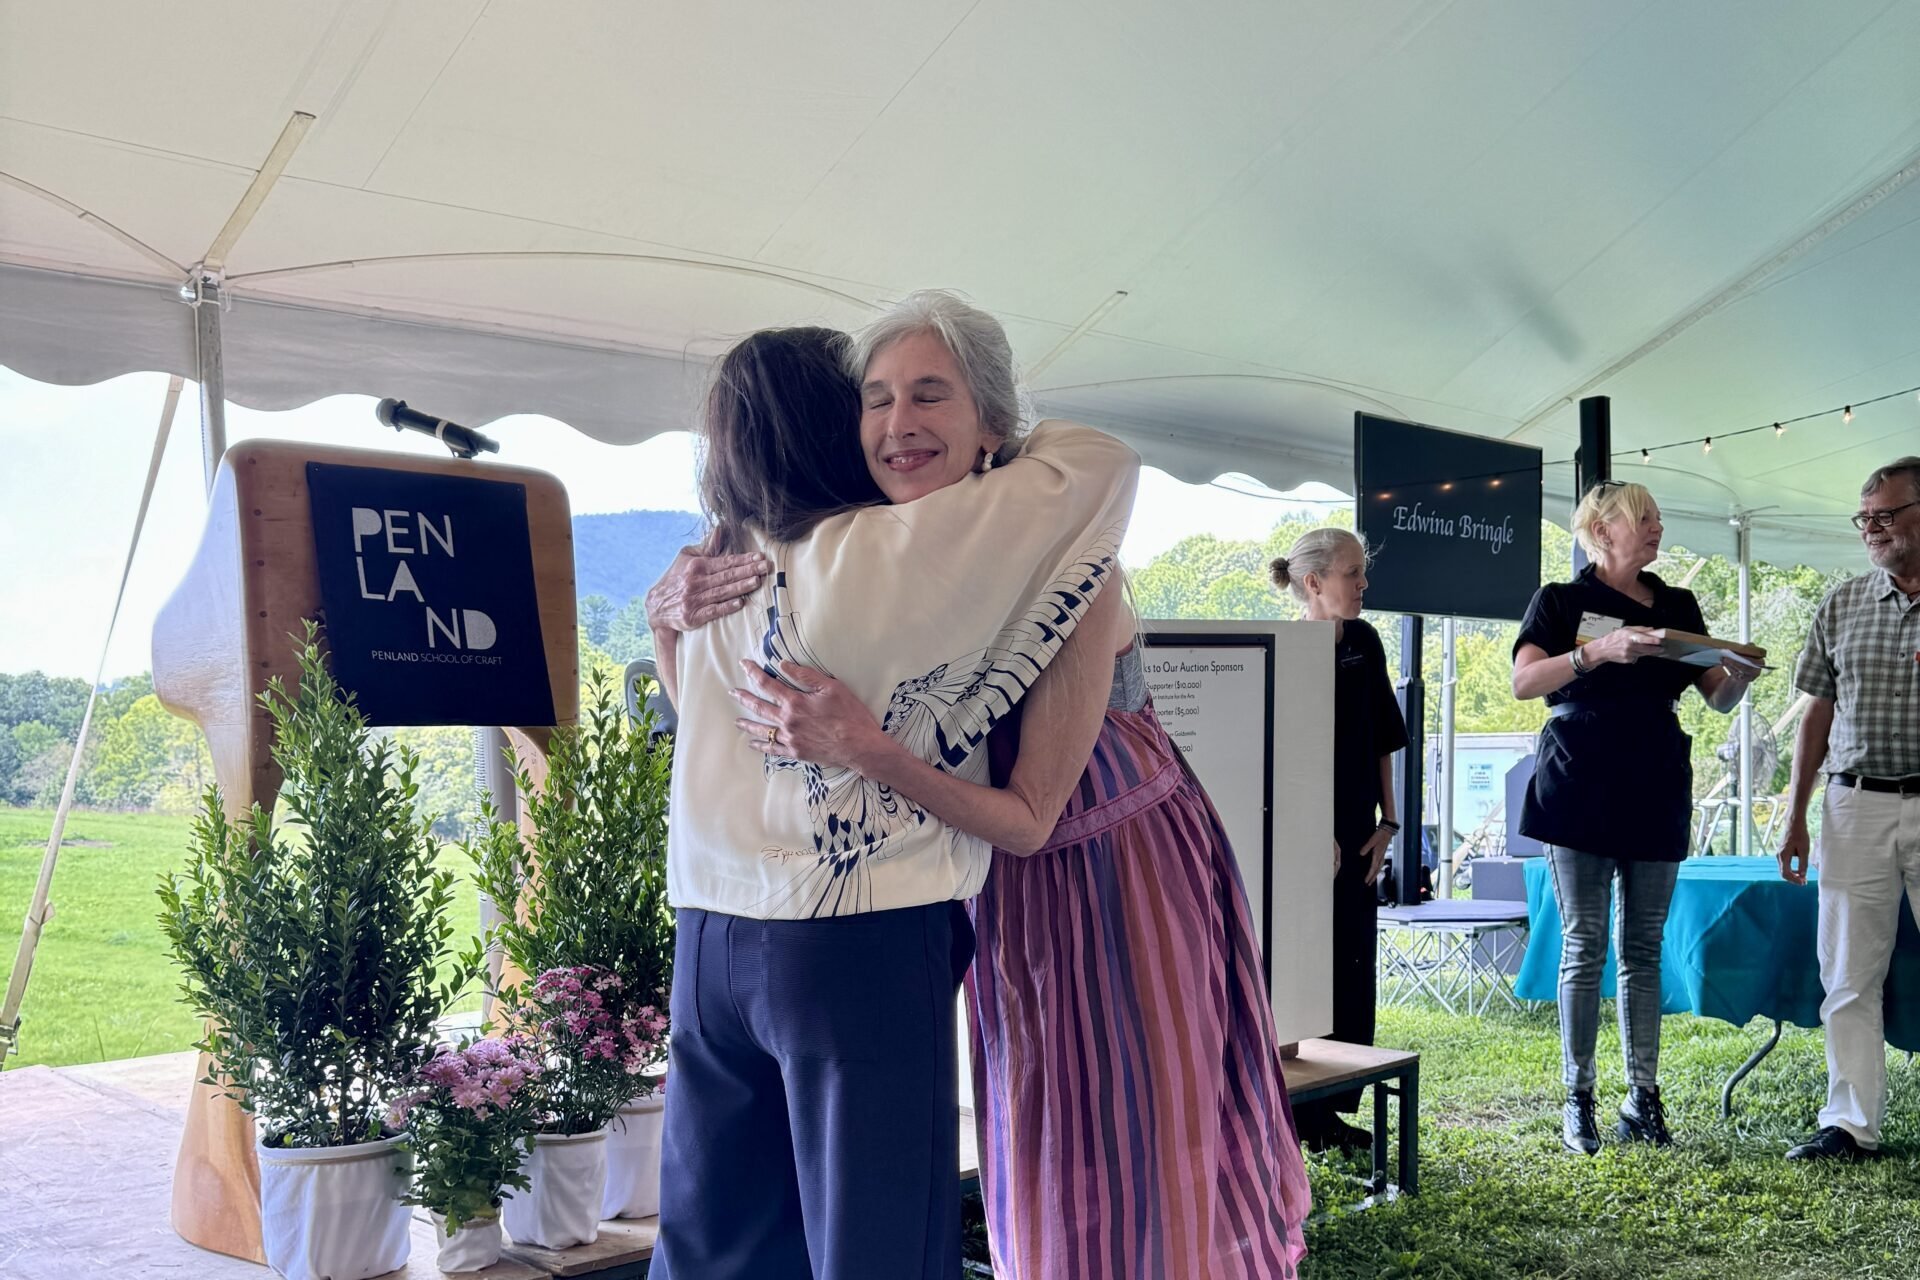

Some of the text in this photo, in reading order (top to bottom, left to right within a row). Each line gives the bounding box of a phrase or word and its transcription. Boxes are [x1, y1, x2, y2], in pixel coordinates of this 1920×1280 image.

[352, 507, 455, 558] PEN
[1393, 502, 1514, 554] Edwina Bringle
[356, 556, 425, 602] LA
[426, 606, 497, 650] ND
[371, 650, 502, 665] PENLAND SCHOOL OF CRAFT
[1153, 664, 1161, 673] to
[1162, 661, 1179, 673] Our
[1179, 661, 1209, 673] Auction
[1210, 660, 1244, 676] Sponsors
[1146, 681, 1174, 692] Supporter
